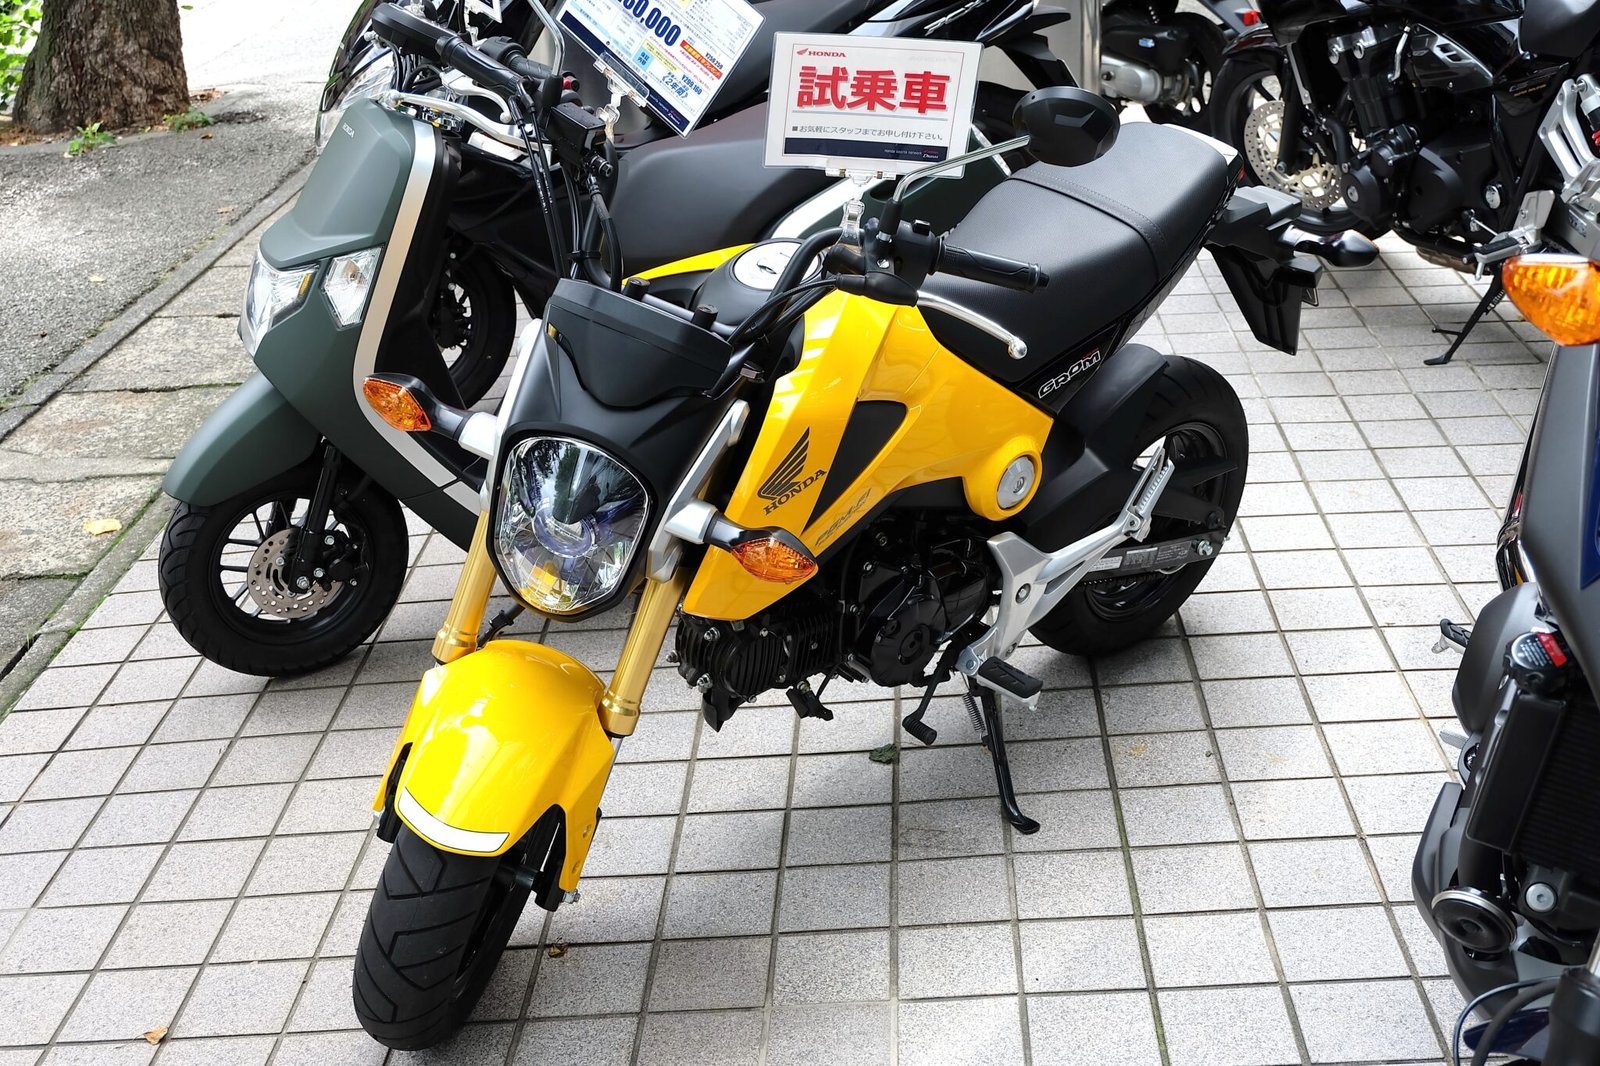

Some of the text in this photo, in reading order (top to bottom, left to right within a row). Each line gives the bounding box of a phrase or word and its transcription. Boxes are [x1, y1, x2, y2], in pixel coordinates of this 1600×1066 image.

[807, 50, 847, 58] HONDA
[796, 66, 951, 115] 試乗車
[1038, 350, 1101, 399] GROM
[762, 469, 828, 516] HONDA
